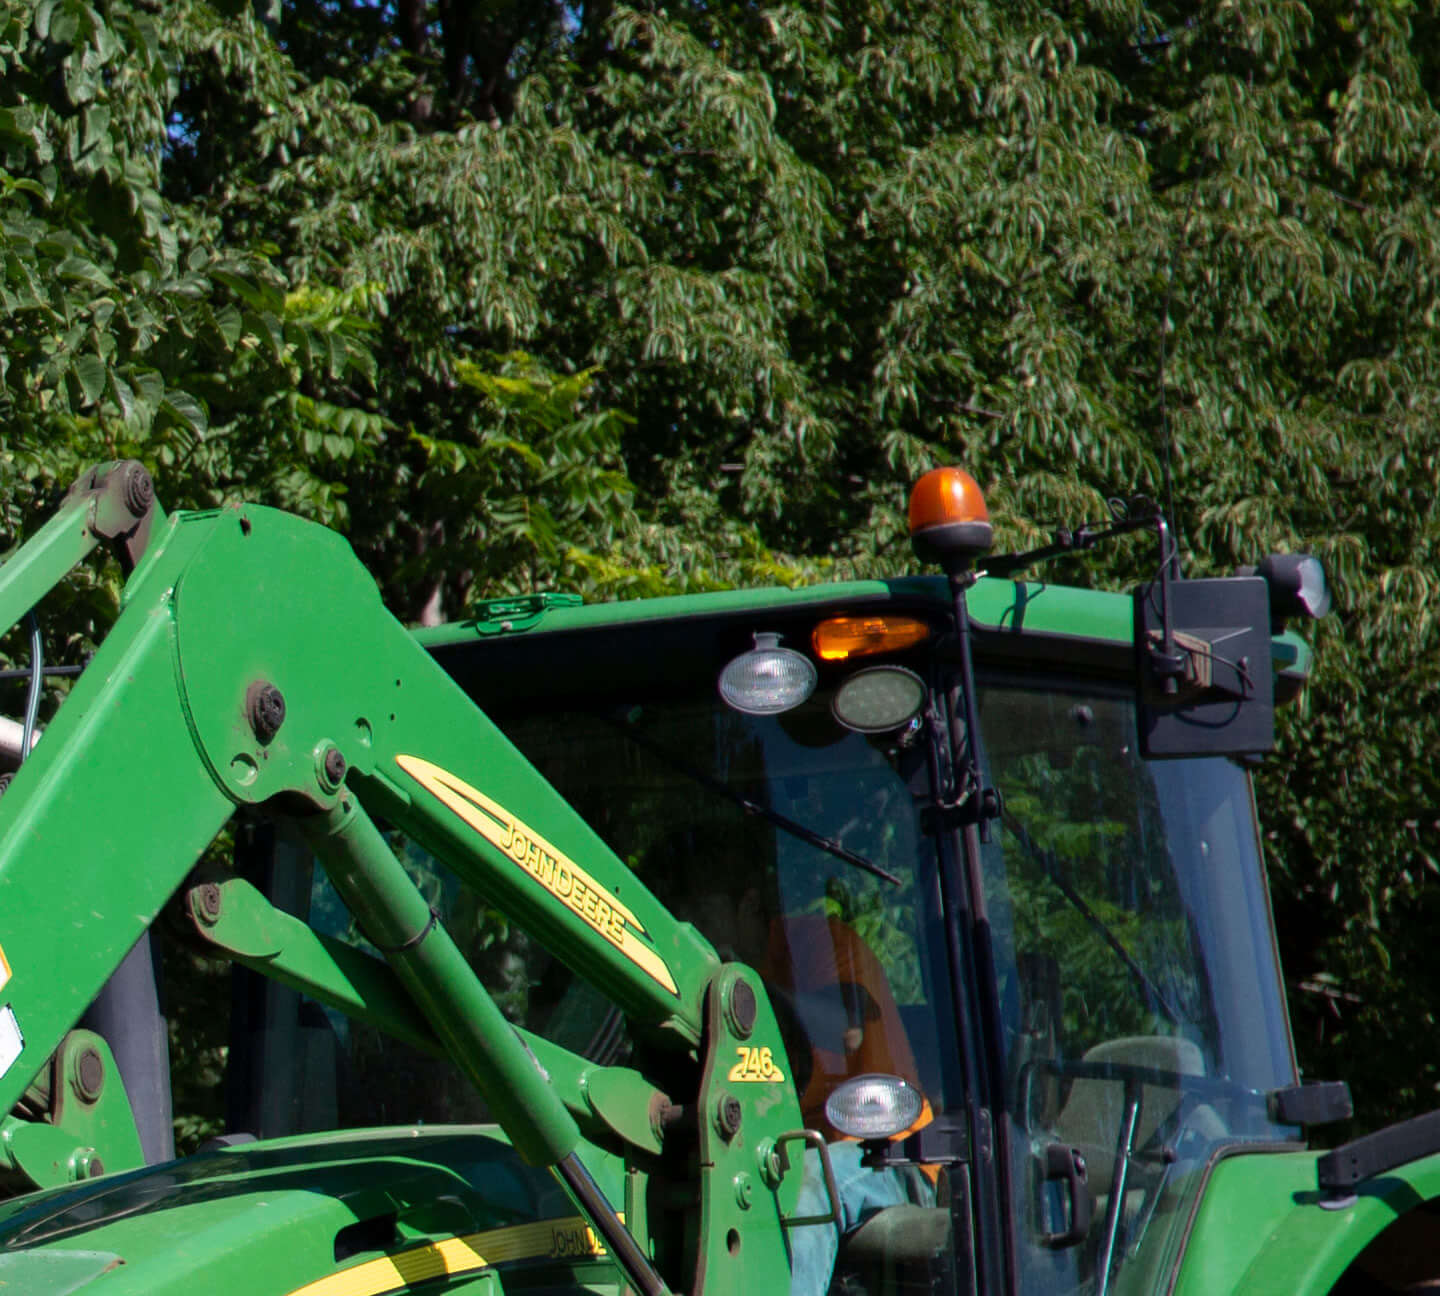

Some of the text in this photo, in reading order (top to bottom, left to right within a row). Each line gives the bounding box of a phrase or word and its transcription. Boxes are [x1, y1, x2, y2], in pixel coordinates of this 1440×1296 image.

[500, 820, 627, 945] JOHN DEERE
[736, 1046, 773, 1078] 746
